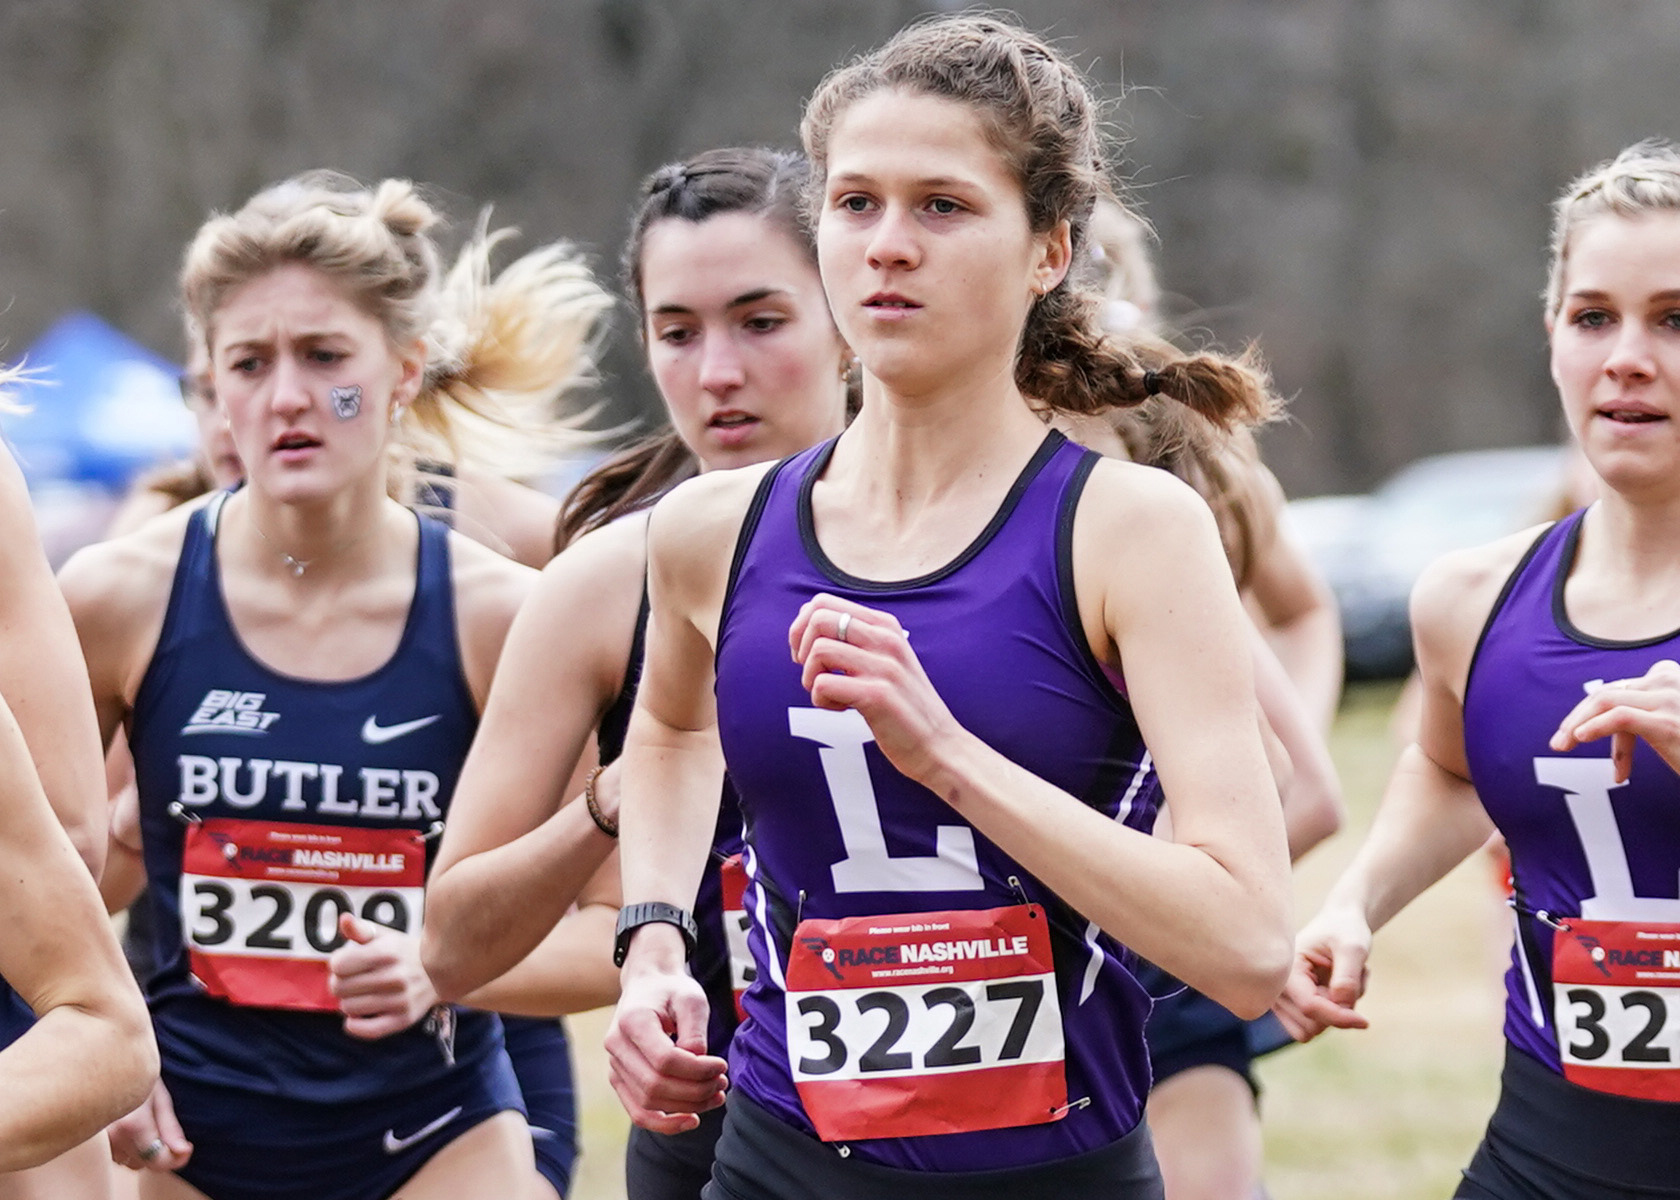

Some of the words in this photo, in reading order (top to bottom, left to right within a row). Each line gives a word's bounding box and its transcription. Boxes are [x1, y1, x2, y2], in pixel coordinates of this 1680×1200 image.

[189, 707, 281, 730] EAST
[200, 689, 267, 711] BIG
[177, 754, 441, 819] BUTLER
[788, 706, 985, 894] L
[1533, 756, 1680, 923] L
[796, 979, 1045, 1076] 3227
[1567, 988, 1672, 1063] 32
